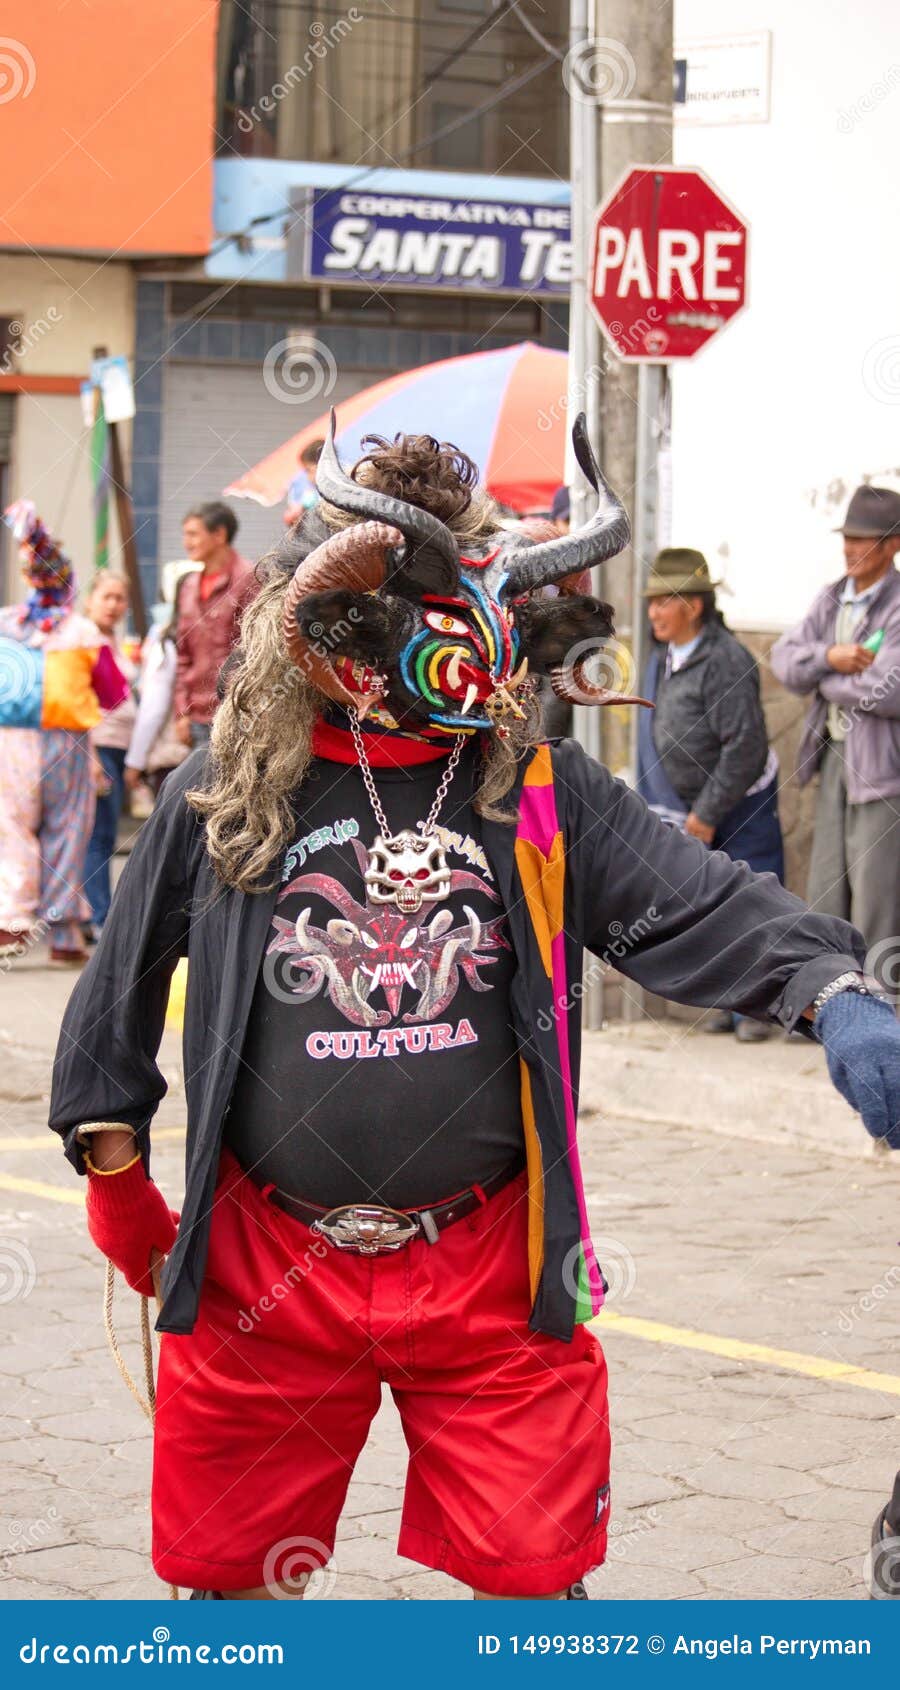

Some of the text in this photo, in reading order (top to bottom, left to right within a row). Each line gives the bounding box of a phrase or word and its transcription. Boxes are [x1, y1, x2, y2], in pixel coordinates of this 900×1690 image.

[339, 194, 571, 229] COOPERATIVA DE
[323, 217, 501, 280] SANTA
[594, 226, 742, 301] PARE
[306, 1018, 478, 1060] CULTURA
